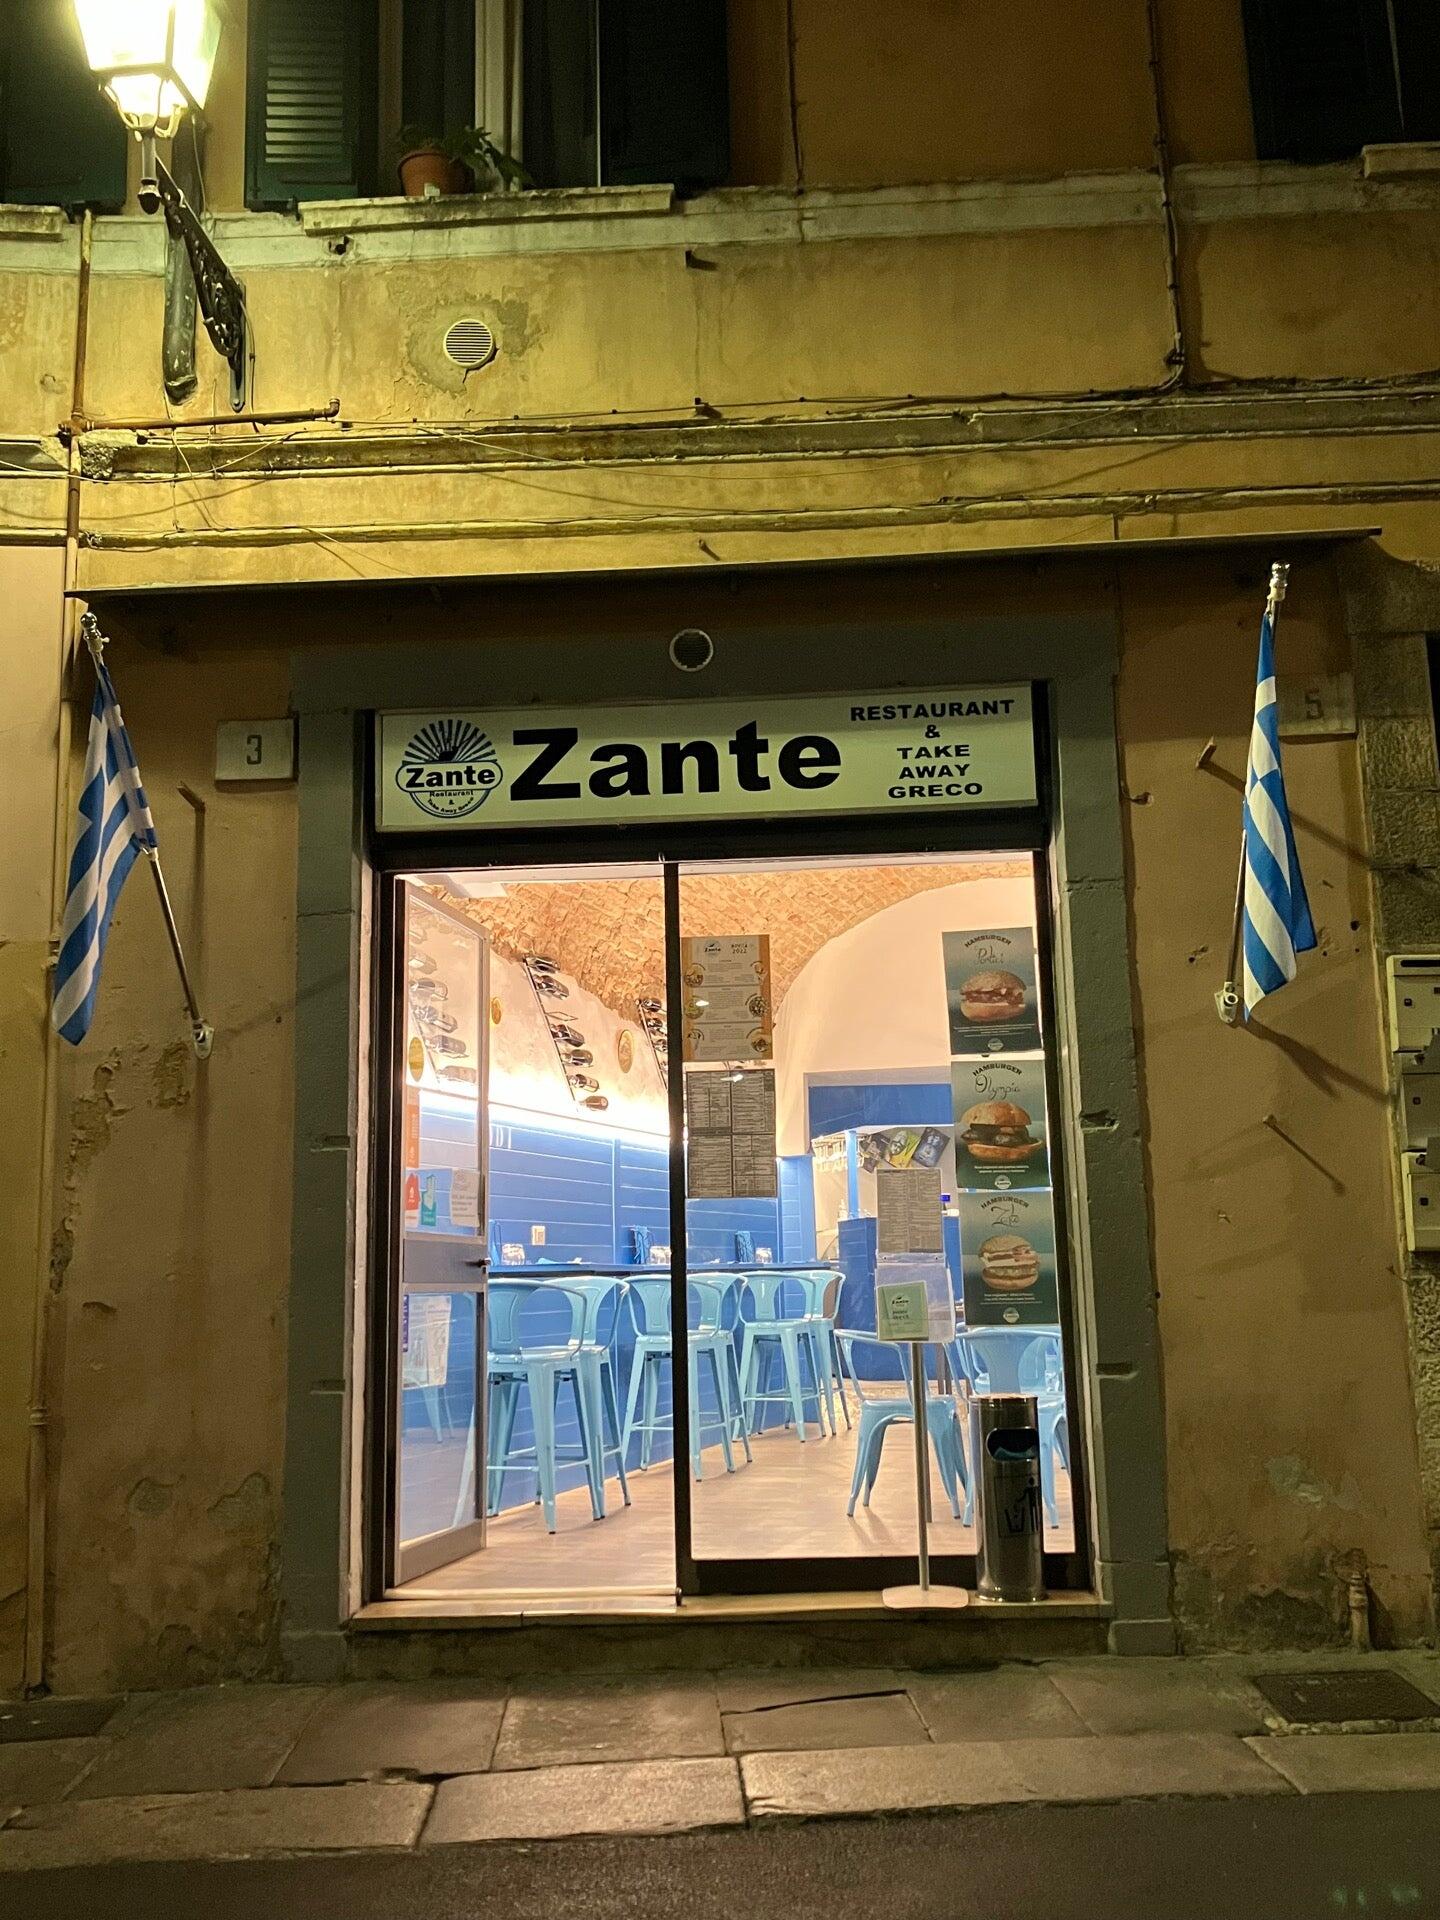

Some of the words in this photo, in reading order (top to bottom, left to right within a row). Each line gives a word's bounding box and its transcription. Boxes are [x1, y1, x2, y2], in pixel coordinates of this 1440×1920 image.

[850, 699, 1015, 722] RESTAURANT
[924, 724, 941, 739] &
[246, 734, 262, 765] 3
[897, 744, 970, 760] TAKE
[510, 720, 842, 802] Zante
[405, 765, 496, 789] Zante
[898, 763, 970, 780] AWAY
[429, 789, 474, 798] Restaurant
[888, 782, 983, 799] GRECO
[964, 934, 1012, 948] HAMBURGER
[972, 1062, 1022, 1076] HAMBURGER
[981, 1195, 1029, 1209] HAMBURGER
